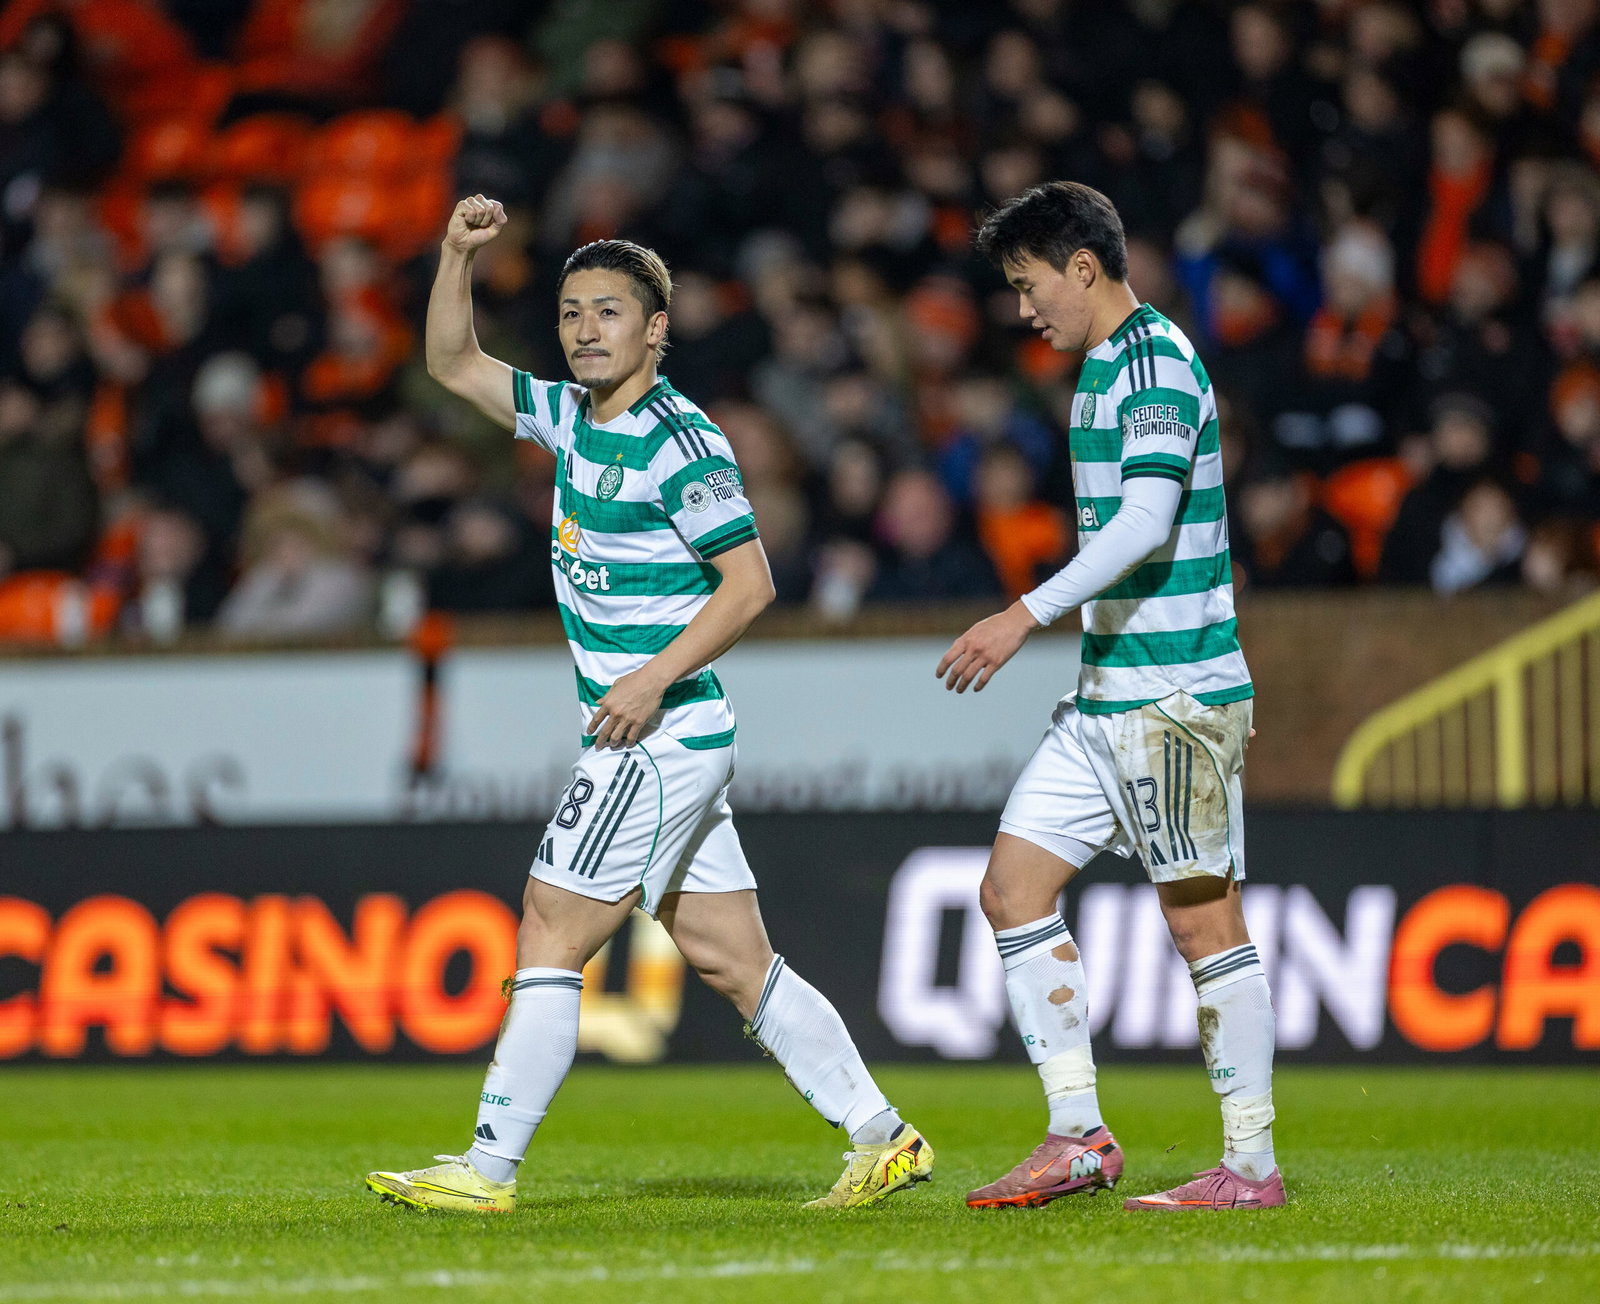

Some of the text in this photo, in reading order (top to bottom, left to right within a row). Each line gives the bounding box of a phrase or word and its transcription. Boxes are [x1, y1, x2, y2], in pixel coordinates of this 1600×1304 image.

[1132, 405, 1179, 424] CELTIC FC
[1134, 420, 1191, 441] FOUNDATION
[705, 469, 732, 488] CELTIC
[554, 777, 595, 830] 8
[1126, 777, 1161, 834] 13
